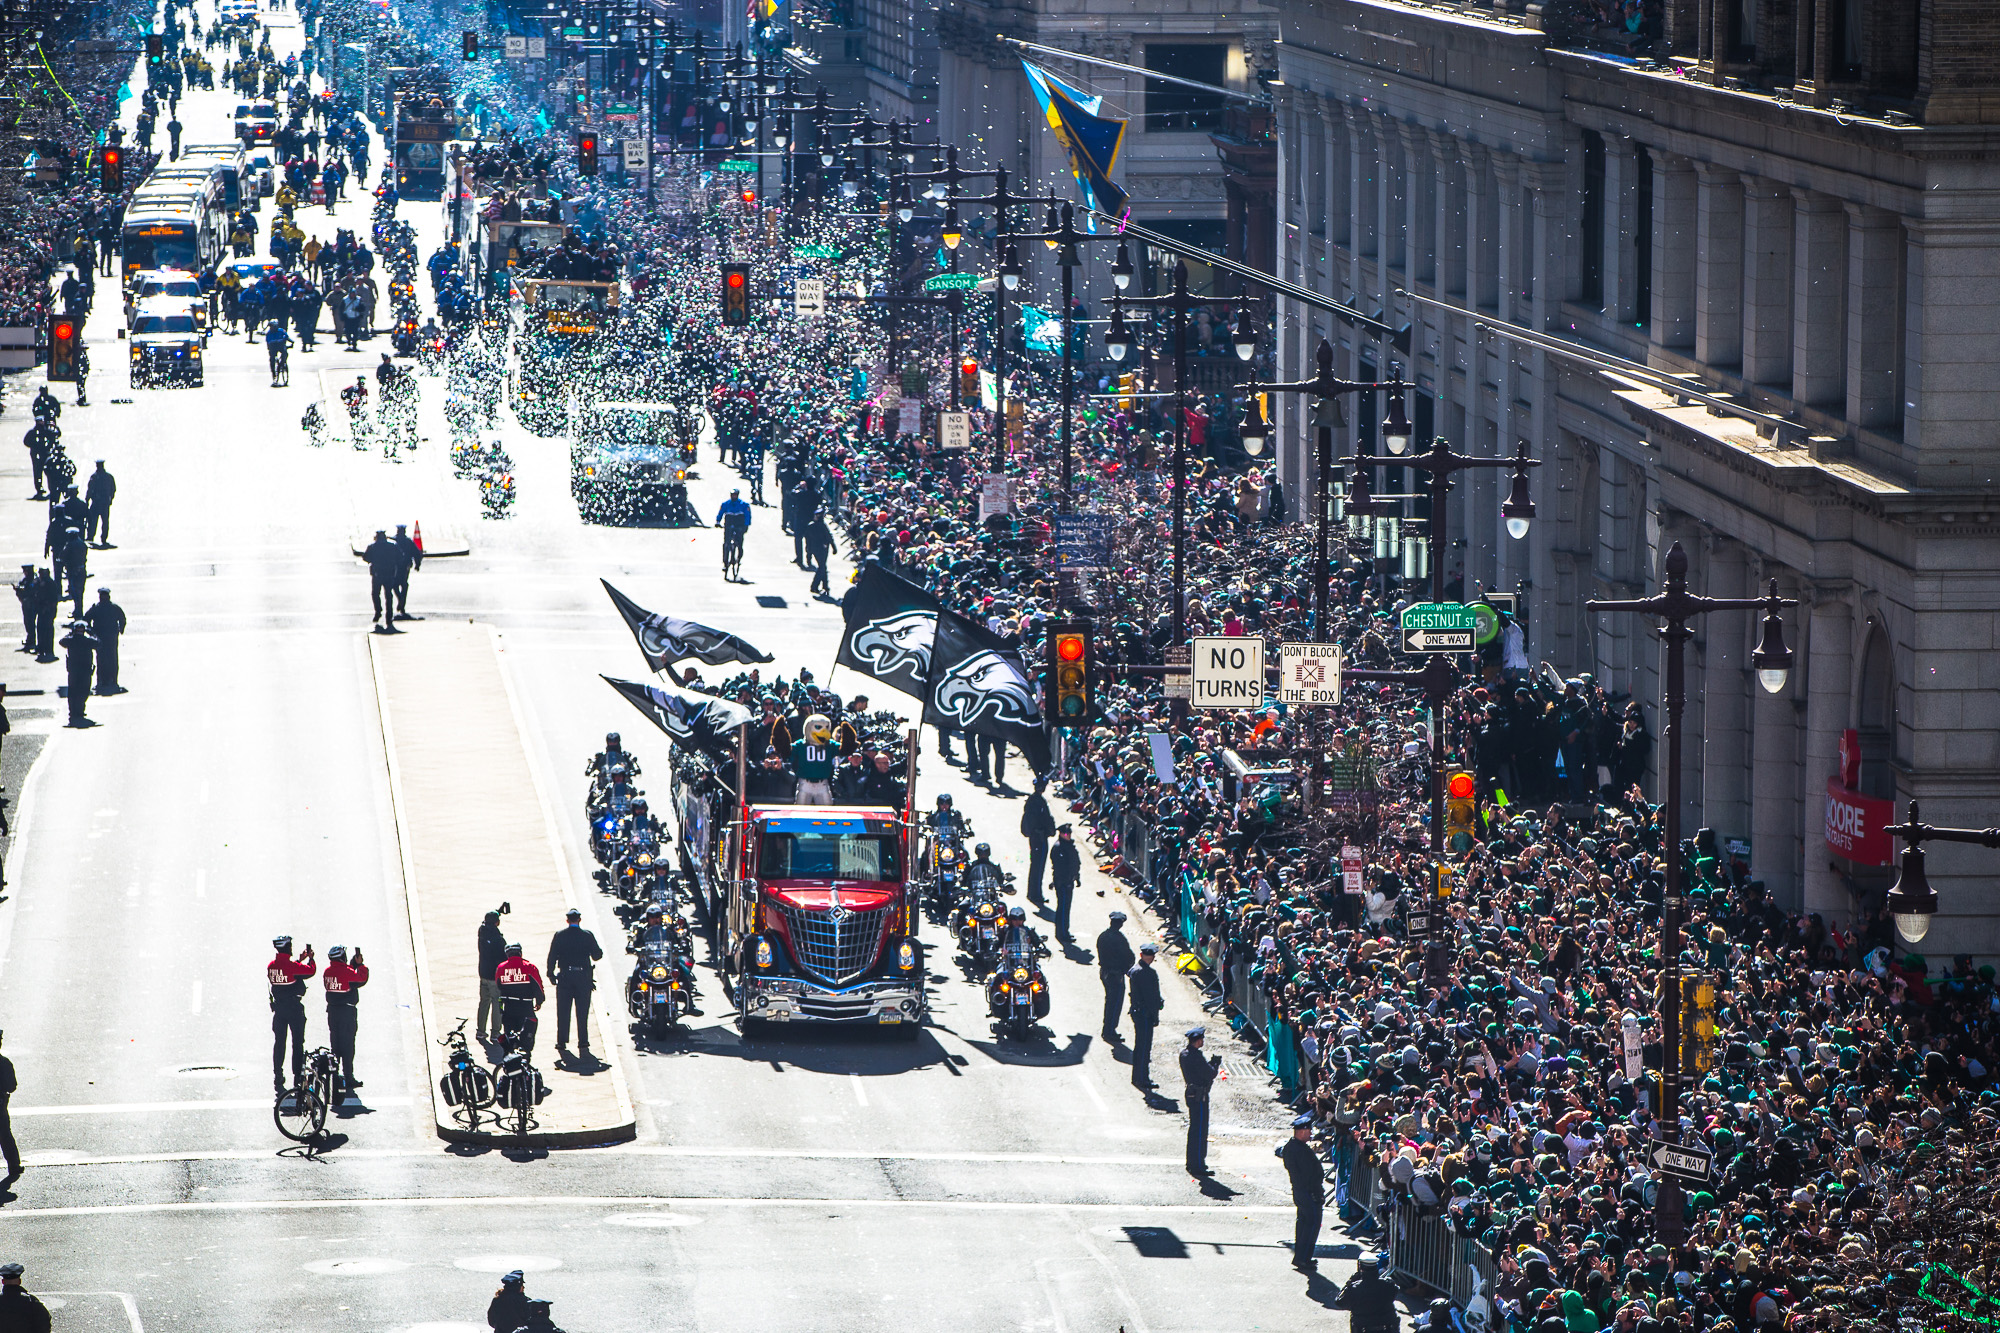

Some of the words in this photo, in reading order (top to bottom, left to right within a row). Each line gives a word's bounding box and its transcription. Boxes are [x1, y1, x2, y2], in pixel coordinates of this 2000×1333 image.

[929, 280, 970, 290] SANSOM
[1405, 613, 1461, 627] CHESTNUT
[1465, 617, 1474, 626] ST
[1425, 635, 1444, 644] ONE
[1447, 635, 1467, 644] WAY
[1211, 648, 1245, 669] NO
[1284, 647, 1307, 658] DONT
[1310, 647, 1338, 658] BLOCK
[1196, 680, 1260, 697] TURNS
[1285, 690, 1306, 701] THE
[1312, 691, 1335, 702] BOX
[1831, 831, 1852, 851] CRAFTS
[1413, 918, 1425, 928] ONE
[504, 968, 522, 976] PHILA
[1665, 1154, 1682, 1166] ONE
[1684, 1157, 1704, 1171] WAY
